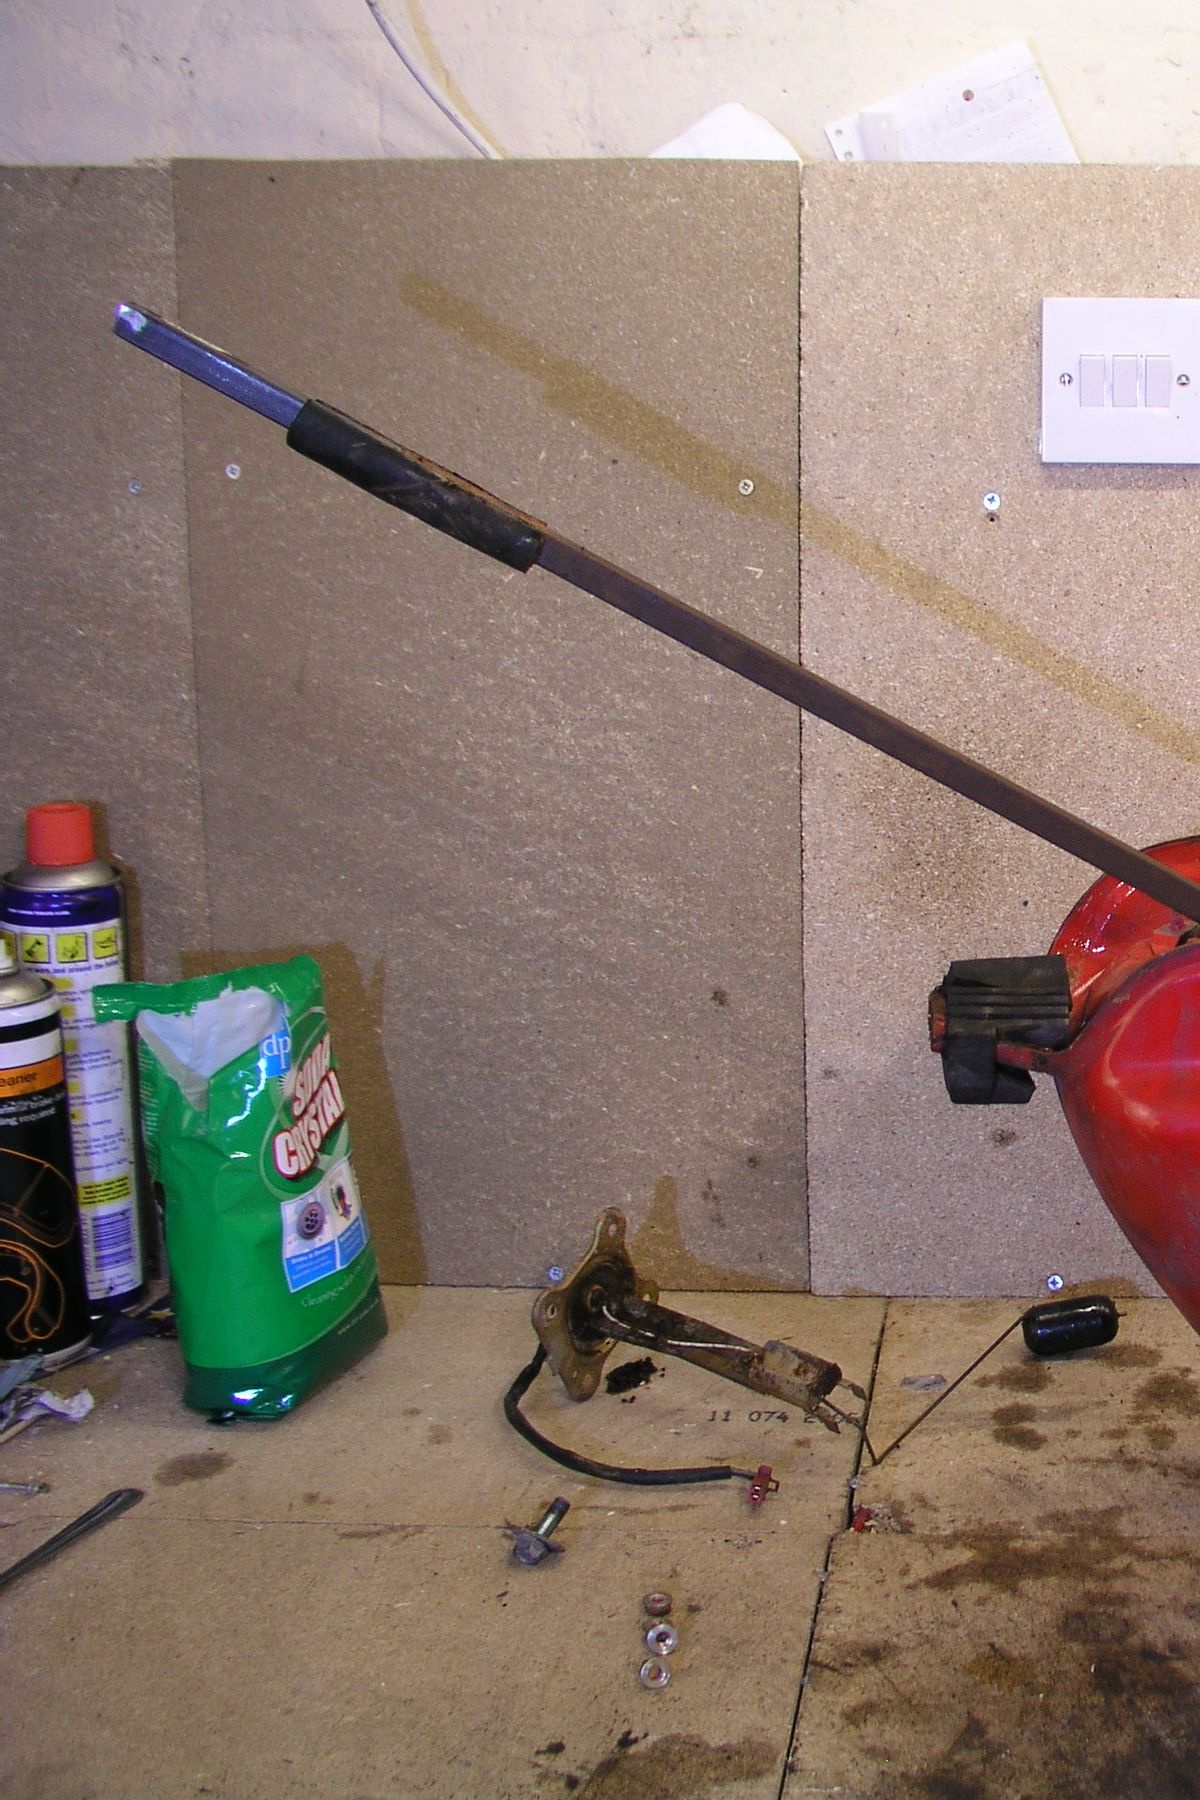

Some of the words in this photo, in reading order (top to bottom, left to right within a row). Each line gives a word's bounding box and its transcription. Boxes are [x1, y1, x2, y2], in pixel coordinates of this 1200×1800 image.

[262, 1033, 292, 1069] dp
[707, 1410, 732, 1423] 11
[748, 1410, 790, 1424] 074
